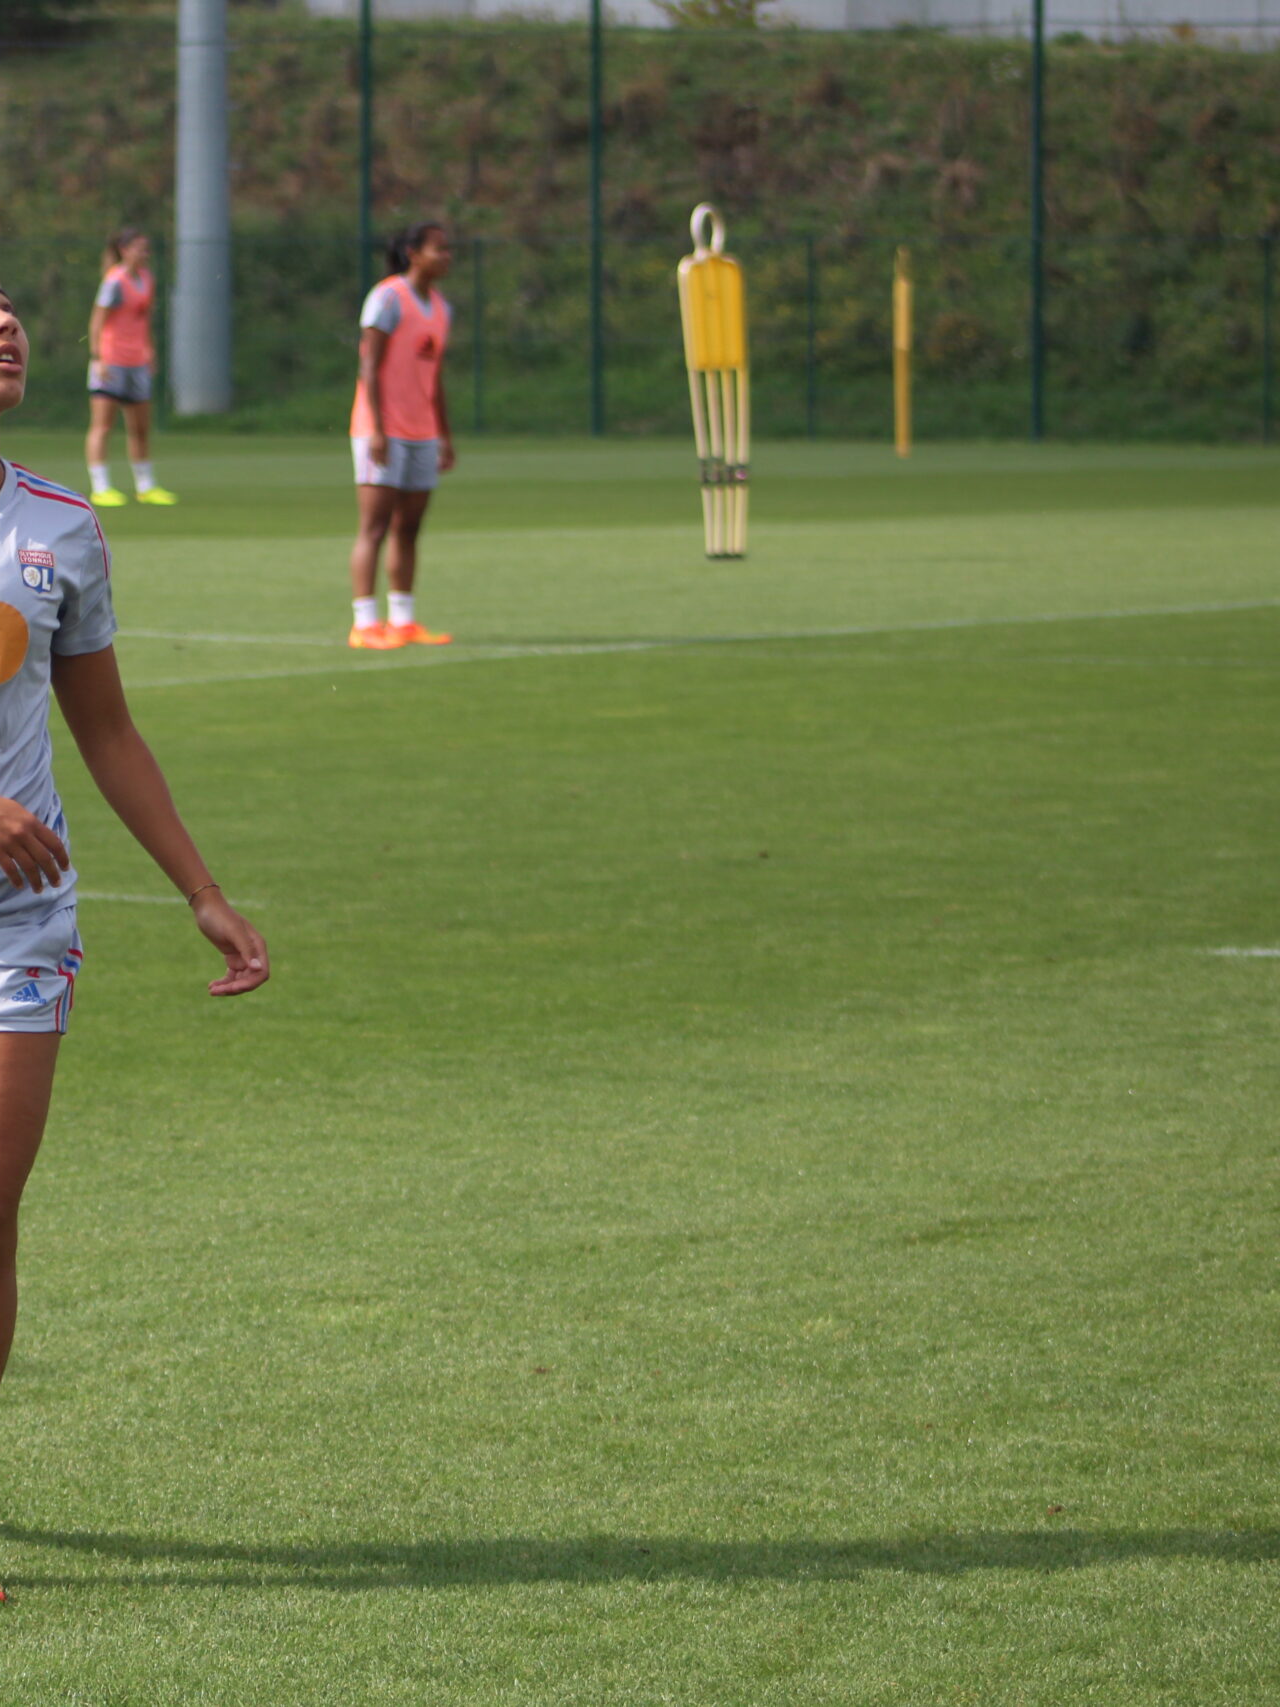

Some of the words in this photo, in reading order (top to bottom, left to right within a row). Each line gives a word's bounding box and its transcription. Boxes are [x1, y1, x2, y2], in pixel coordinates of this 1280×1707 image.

[19, 551, 52, 559] OLYMPIQUE
[21, 556, 53, 566] LYONNAIS
[23, 566, 51, 591] OL
